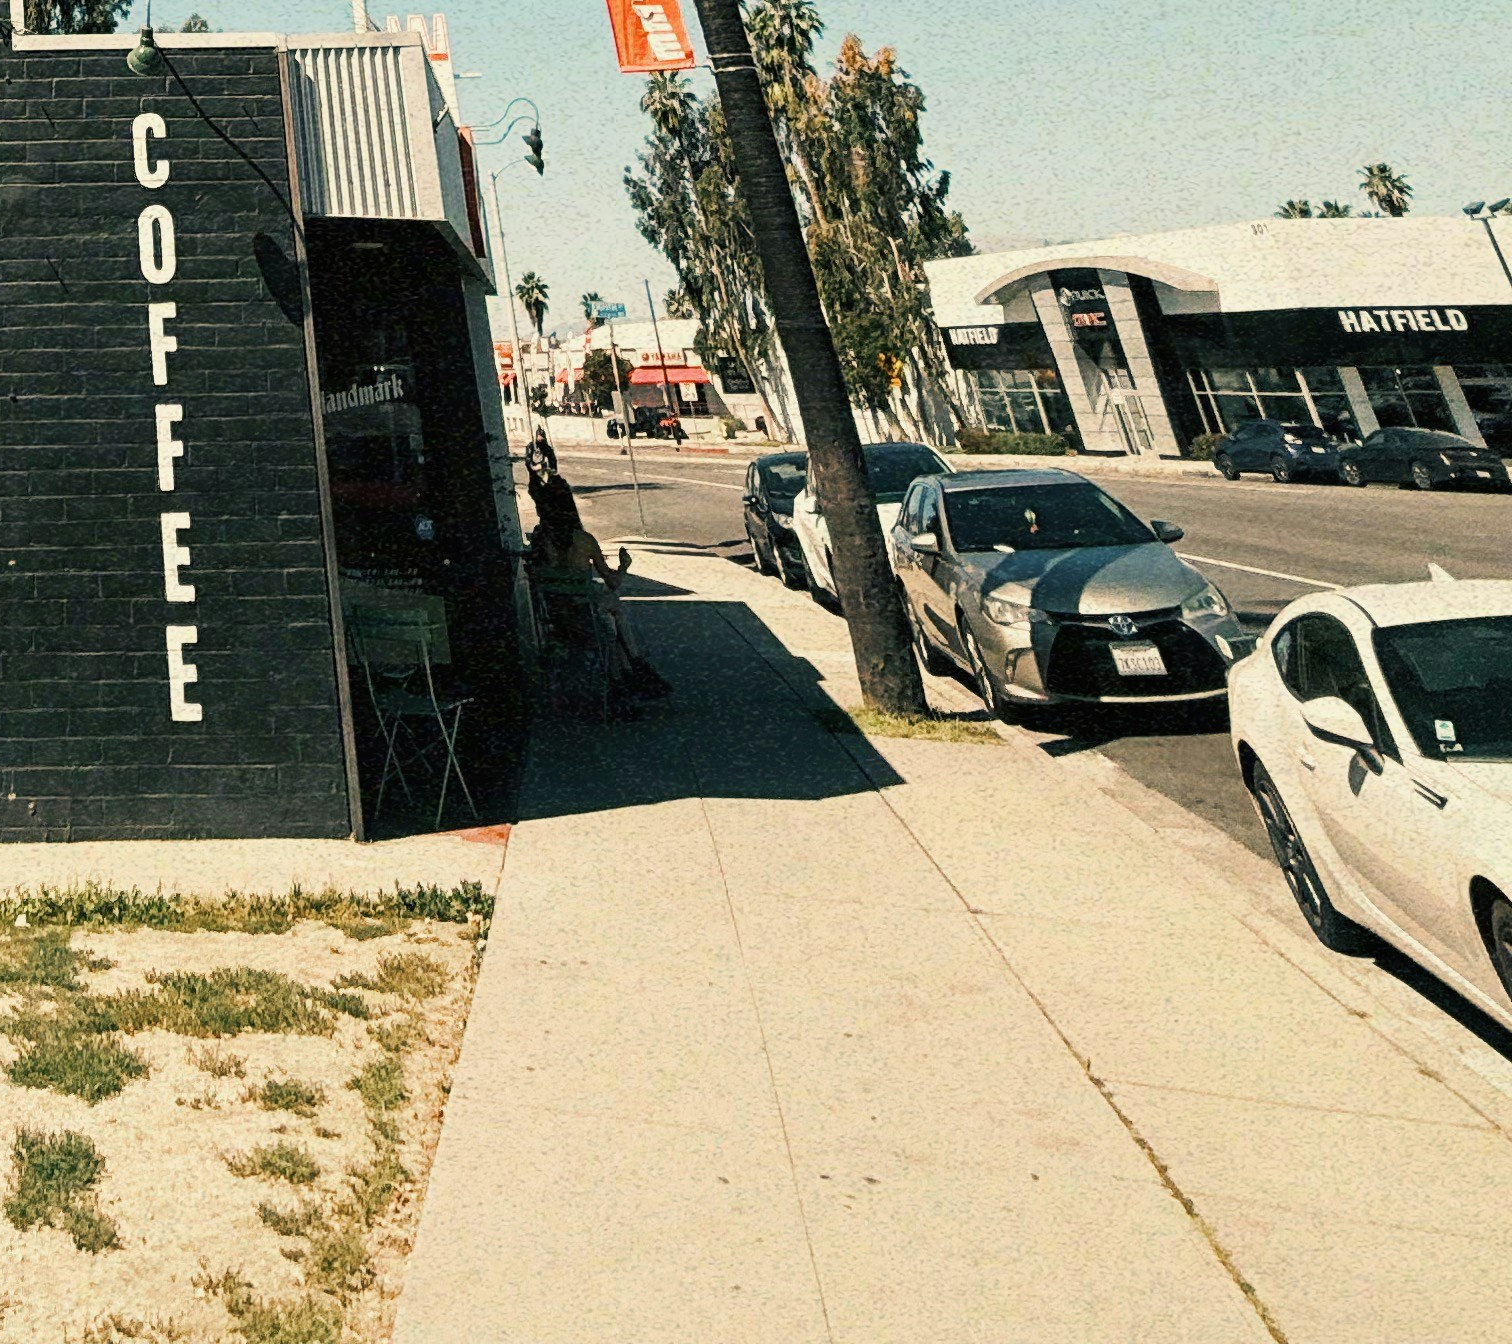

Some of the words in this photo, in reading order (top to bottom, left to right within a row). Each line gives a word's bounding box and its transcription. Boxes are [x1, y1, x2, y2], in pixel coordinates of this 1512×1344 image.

[949, 327, 999, 345] HATFIELD
[1337, 309, 1468, 332] HATFIELD
[321, 374, 404, 415] landmark
[131, 112, 203, 722] COFFEE
